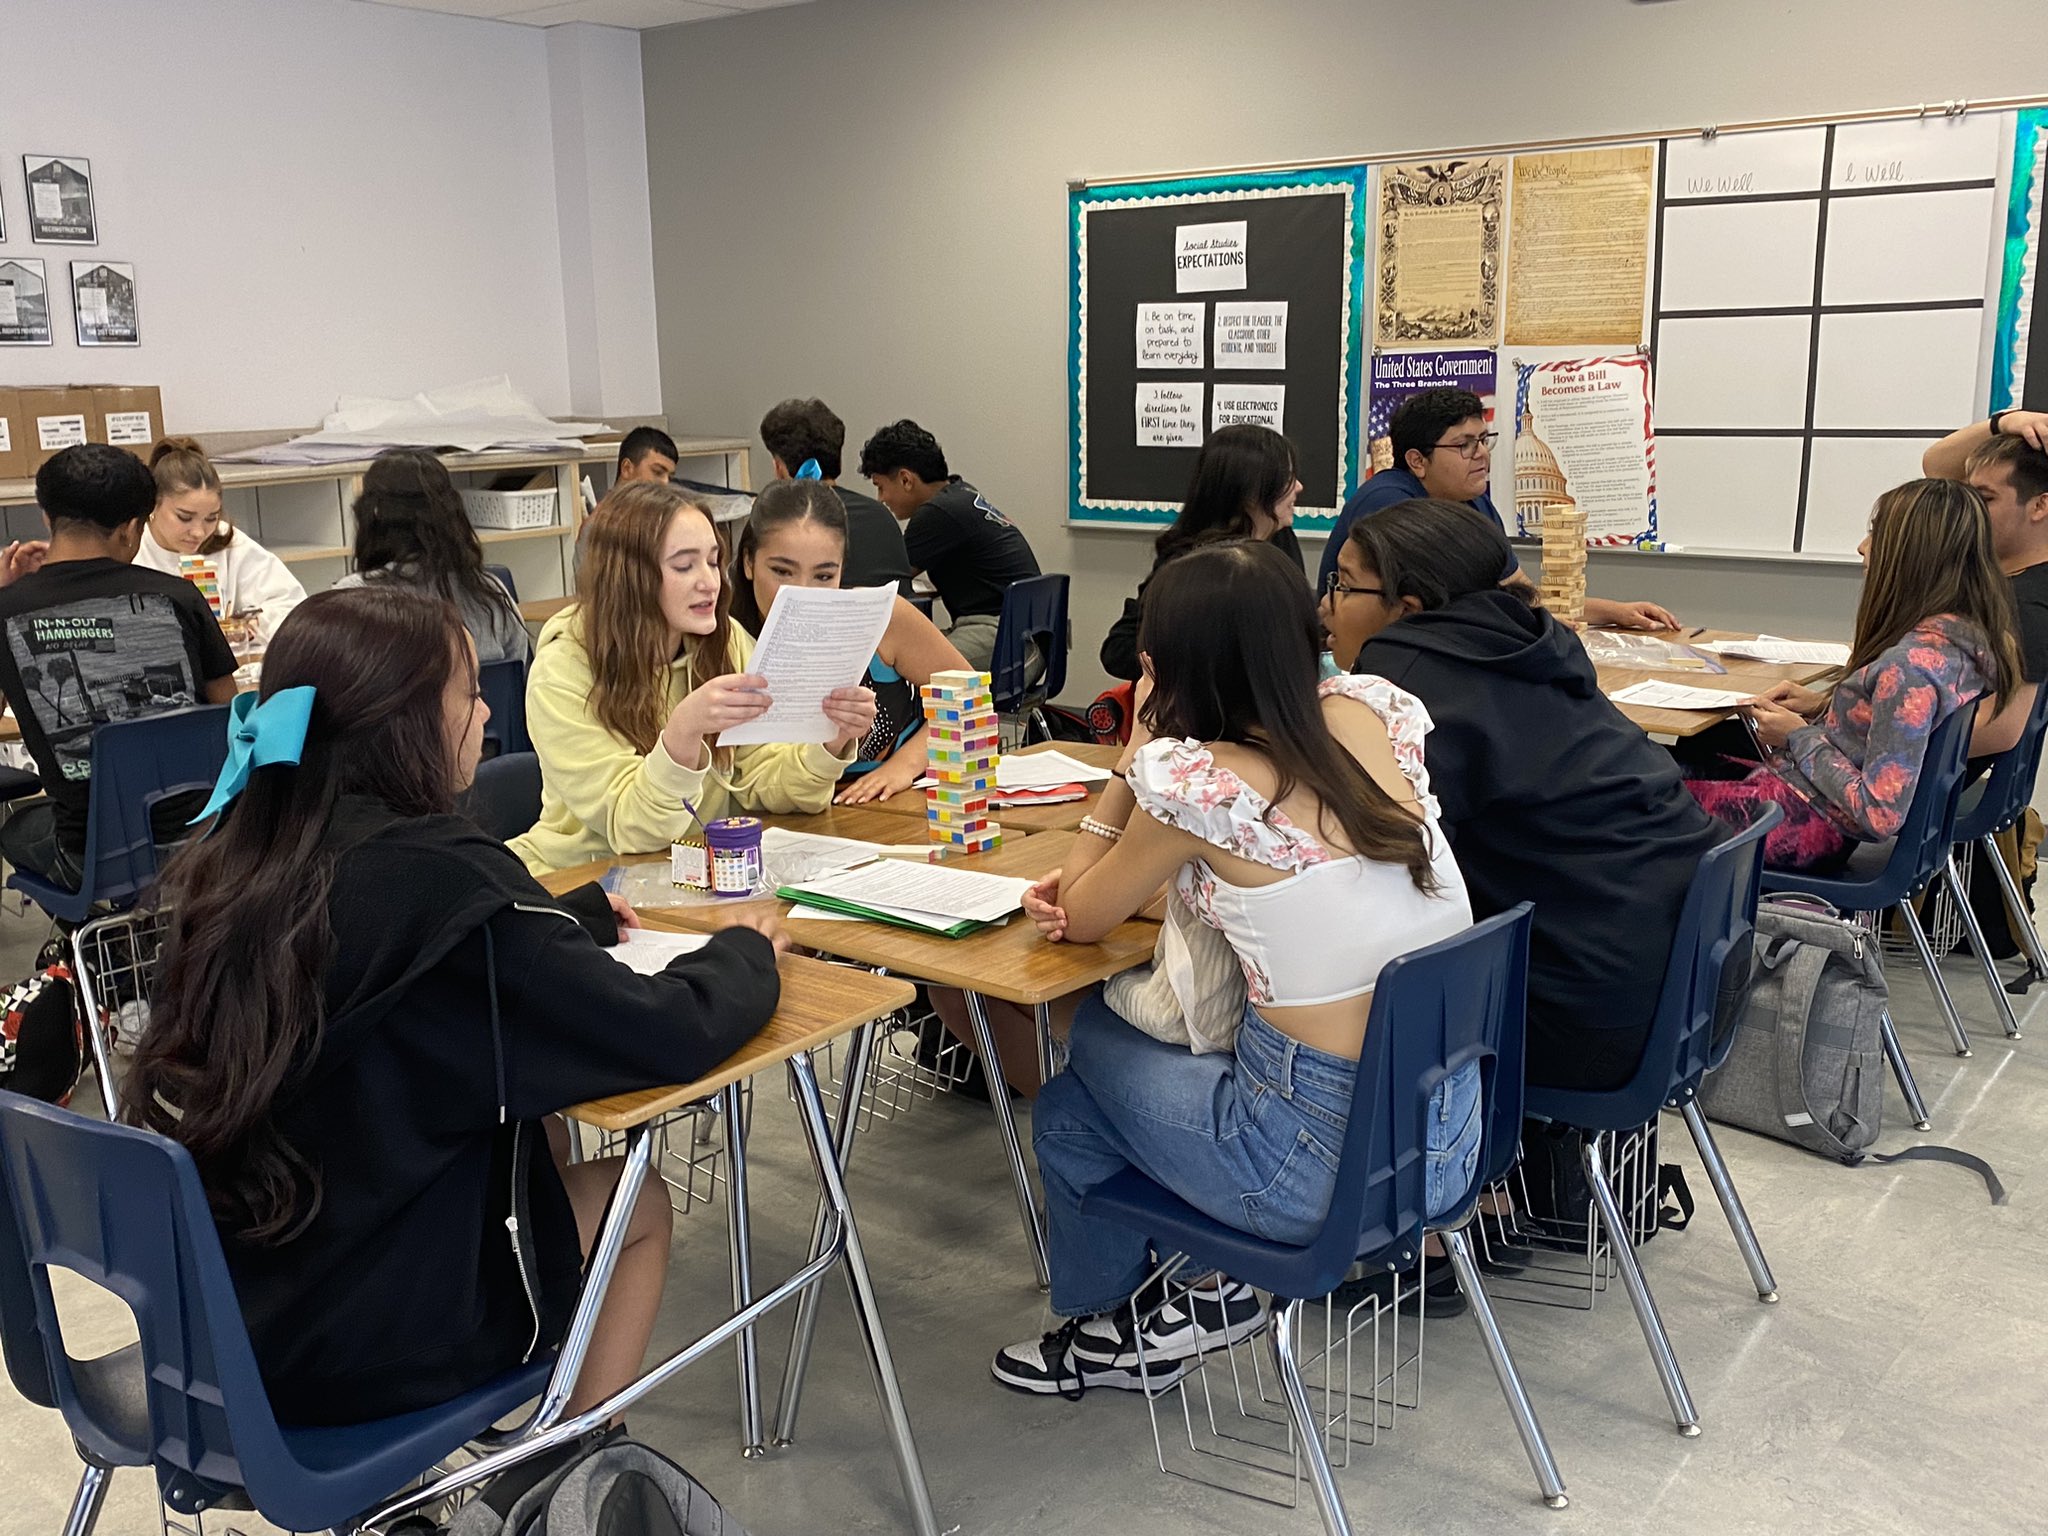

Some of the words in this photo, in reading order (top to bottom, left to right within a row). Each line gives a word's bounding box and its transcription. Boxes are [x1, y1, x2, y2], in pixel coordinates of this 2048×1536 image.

[1688, 177, 1714, 194] We
[1183, 240, 1209, 251] Social
[1210, 238, 1239, 249] Studies
[1177, 251, 1244, 270] EXPECTATIONS
[1151, 311, 1160, 321] Be
[1164, 313, 1174, 321] on
[1178, 310, 1196, 321] time,
[1274, 315, 1283, 326] THE
[1180, 324, 1194, 333] and
[1146, 337, 1179, 349] prepared
[1183, 336, 1192, 347] to
[1142, 349, 1161, 360] learn
[1164, 350, 1198, 365] everyday
[1375, 356, 1405, 379] United
[1406, 356, 1433, 378] States
[1435, 354, 1493, 377] Government
[1553, 374, 1576, 385] How
[1578, 374, 1585, 382] a
[1588, 369, 1607, 381] Bill
[1418, 379, 1458, 388] Branches
[1541, 385, 1586, 396] Becomes
[1588, 384, 1595, 392] a
[1598, 381, 1622, 391] Law
[1144, 403, 1177, 414] directions
[1180, 403, 1192, 413] the
[1223, 401, 1235, 410] USE
[1236, 401, 1278, 411] ELECTRONICS
[1141, 416, 1160, 428] FIRST
[1162, 419, 1178, 429] time
[1180, 419, 1196, 432] they
[1219, 414, 1231, 424] FOR
[1232, 415, 1275, 425] EDUCATIONAL
[1152, 434, 1164, 442] are
[1165, 433, 1184, 445] given
[33, 618, 96, 629] IN-N-OUT
[35, 628, 114, 641] HAMBURGERS
[62, 641, 91, 649] DELAY
